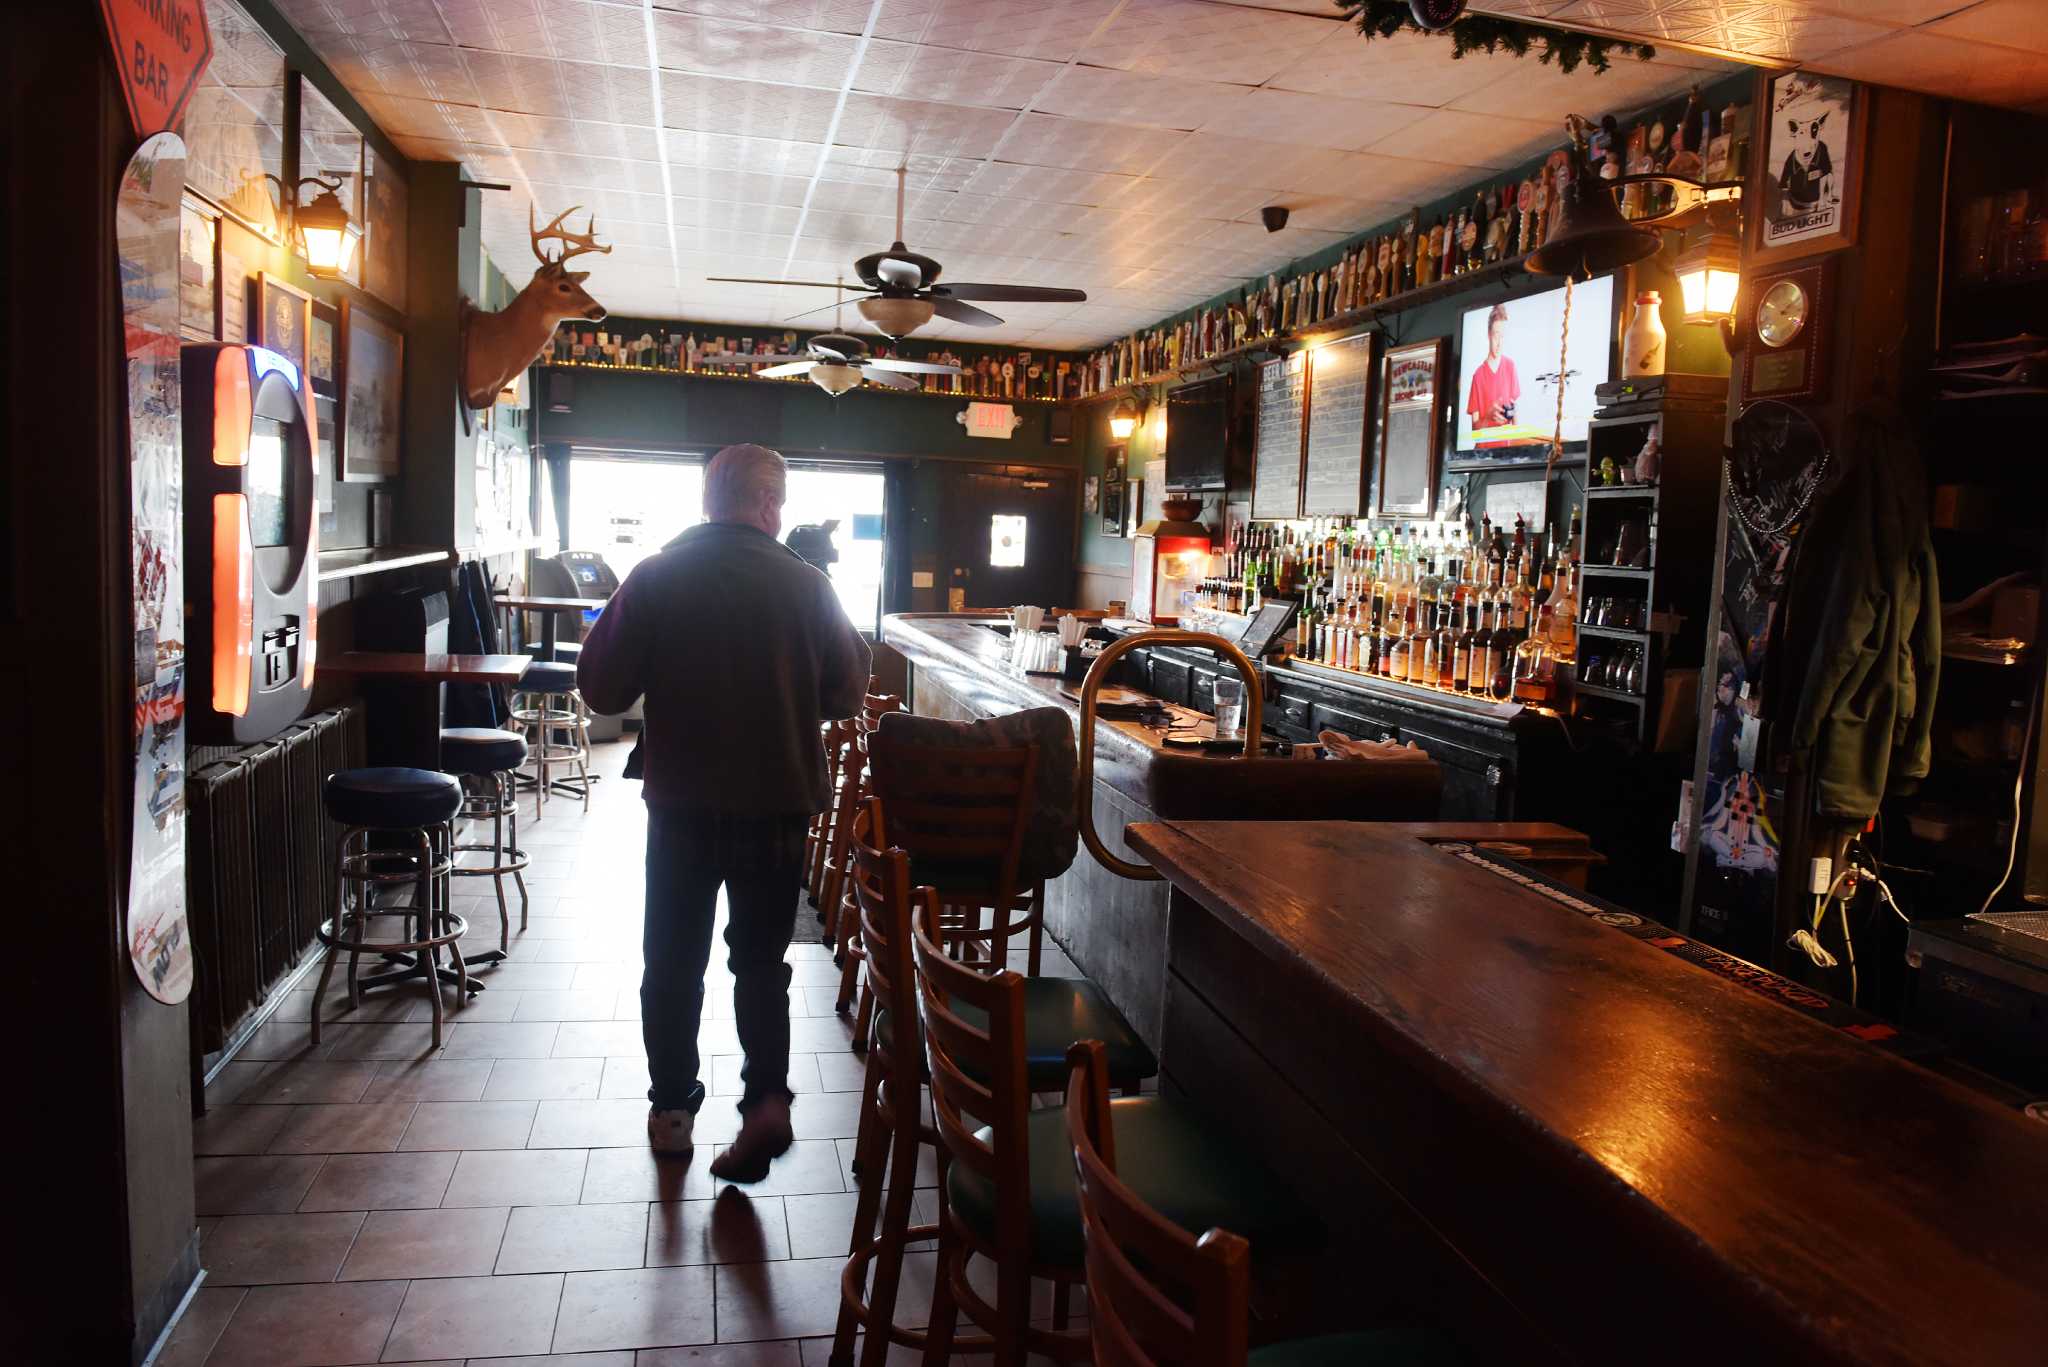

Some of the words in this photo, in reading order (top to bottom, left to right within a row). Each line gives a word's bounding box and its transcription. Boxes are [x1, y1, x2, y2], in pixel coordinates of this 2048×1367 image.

[134, 40, 168, 107] BAR
[1772, 222, 1796, 235] BUD
[1797, 212, 1831, 229] LIGHT
[1392, 360, 1433, 378] NEWCASTLE
[977, 406, 1008, 429] EXIT
[571, 552, 594, 560] ATM
